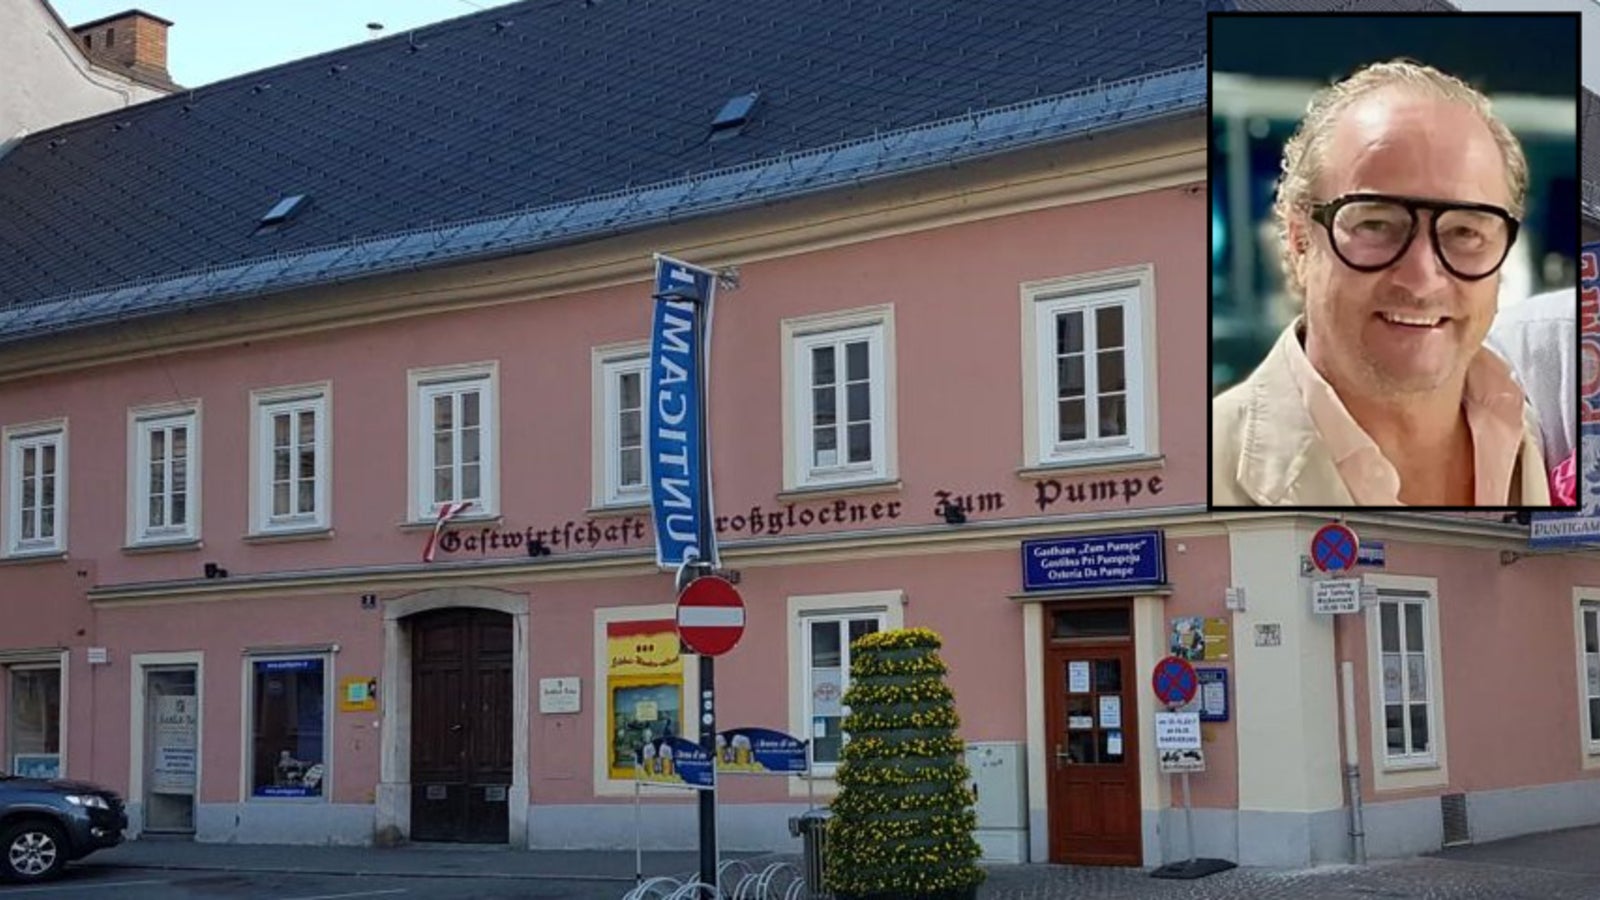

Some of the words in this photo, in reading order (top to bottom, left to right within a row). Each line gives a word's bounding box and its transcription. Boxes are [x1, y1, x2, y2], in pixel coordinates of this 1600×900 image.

[716, 499, 902, 535] roßglockner
[1035, 473, 1164, 512] Pumpe
[1033, 545, 1077, 558] Gasthaus
[1084, 567, 1098, 577] Da
[1100, 566, 1135, 578] Pumpe
